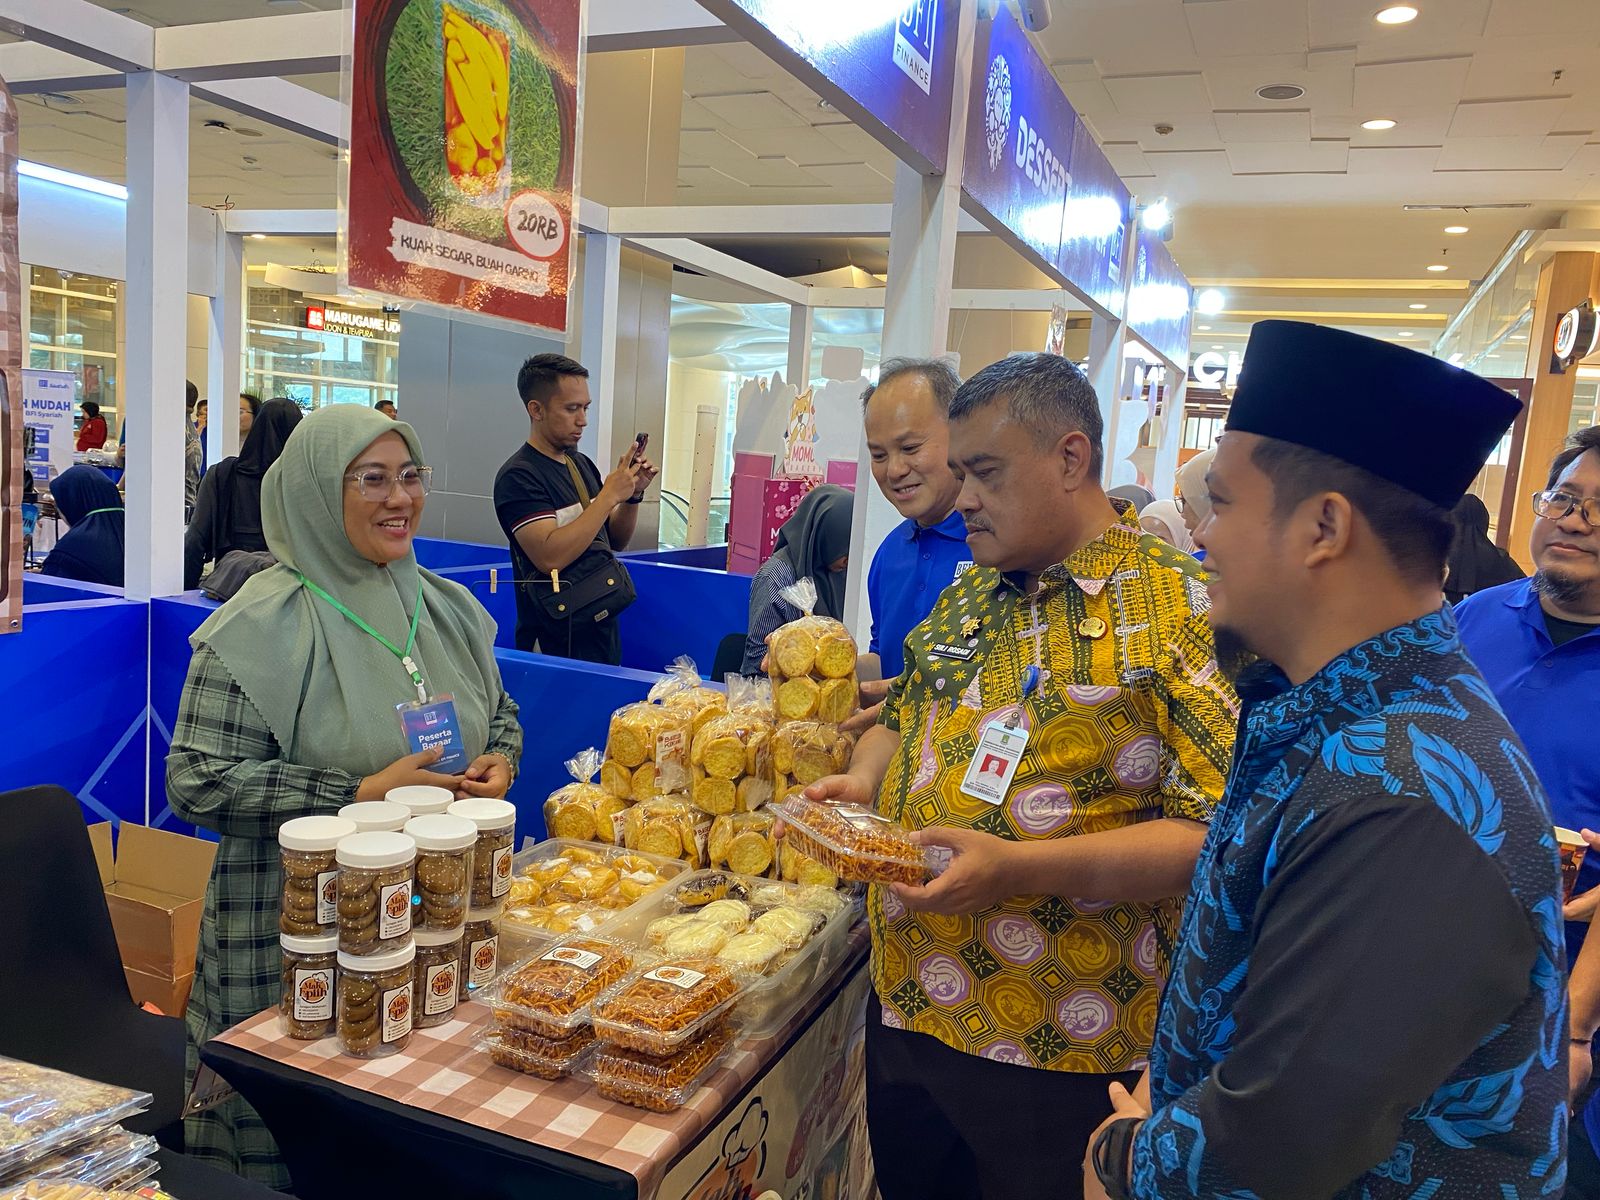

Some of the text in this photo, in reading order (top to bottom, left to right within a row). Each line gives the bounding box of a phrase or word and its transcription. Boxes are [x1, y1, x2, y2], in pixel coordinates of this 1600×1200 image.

[896, 43, 929, 86] FINANCE
[517, 209, 558, 241] 20RB
[400, 234, 434, 254] KUAH
[476, 255, 504, 273] BUAH
[324, 309, 384, 331] MARUGAME
[323, 323, 341, 333] UDON
[349, 327, 374, 338] TEMPURA
[31, 399, 71, 411] MUDAH
[37, 411, 63, 419] Syariah
[418, 729, 452, 743] Peserta
[422, 738, 452, 751] Bazaar
